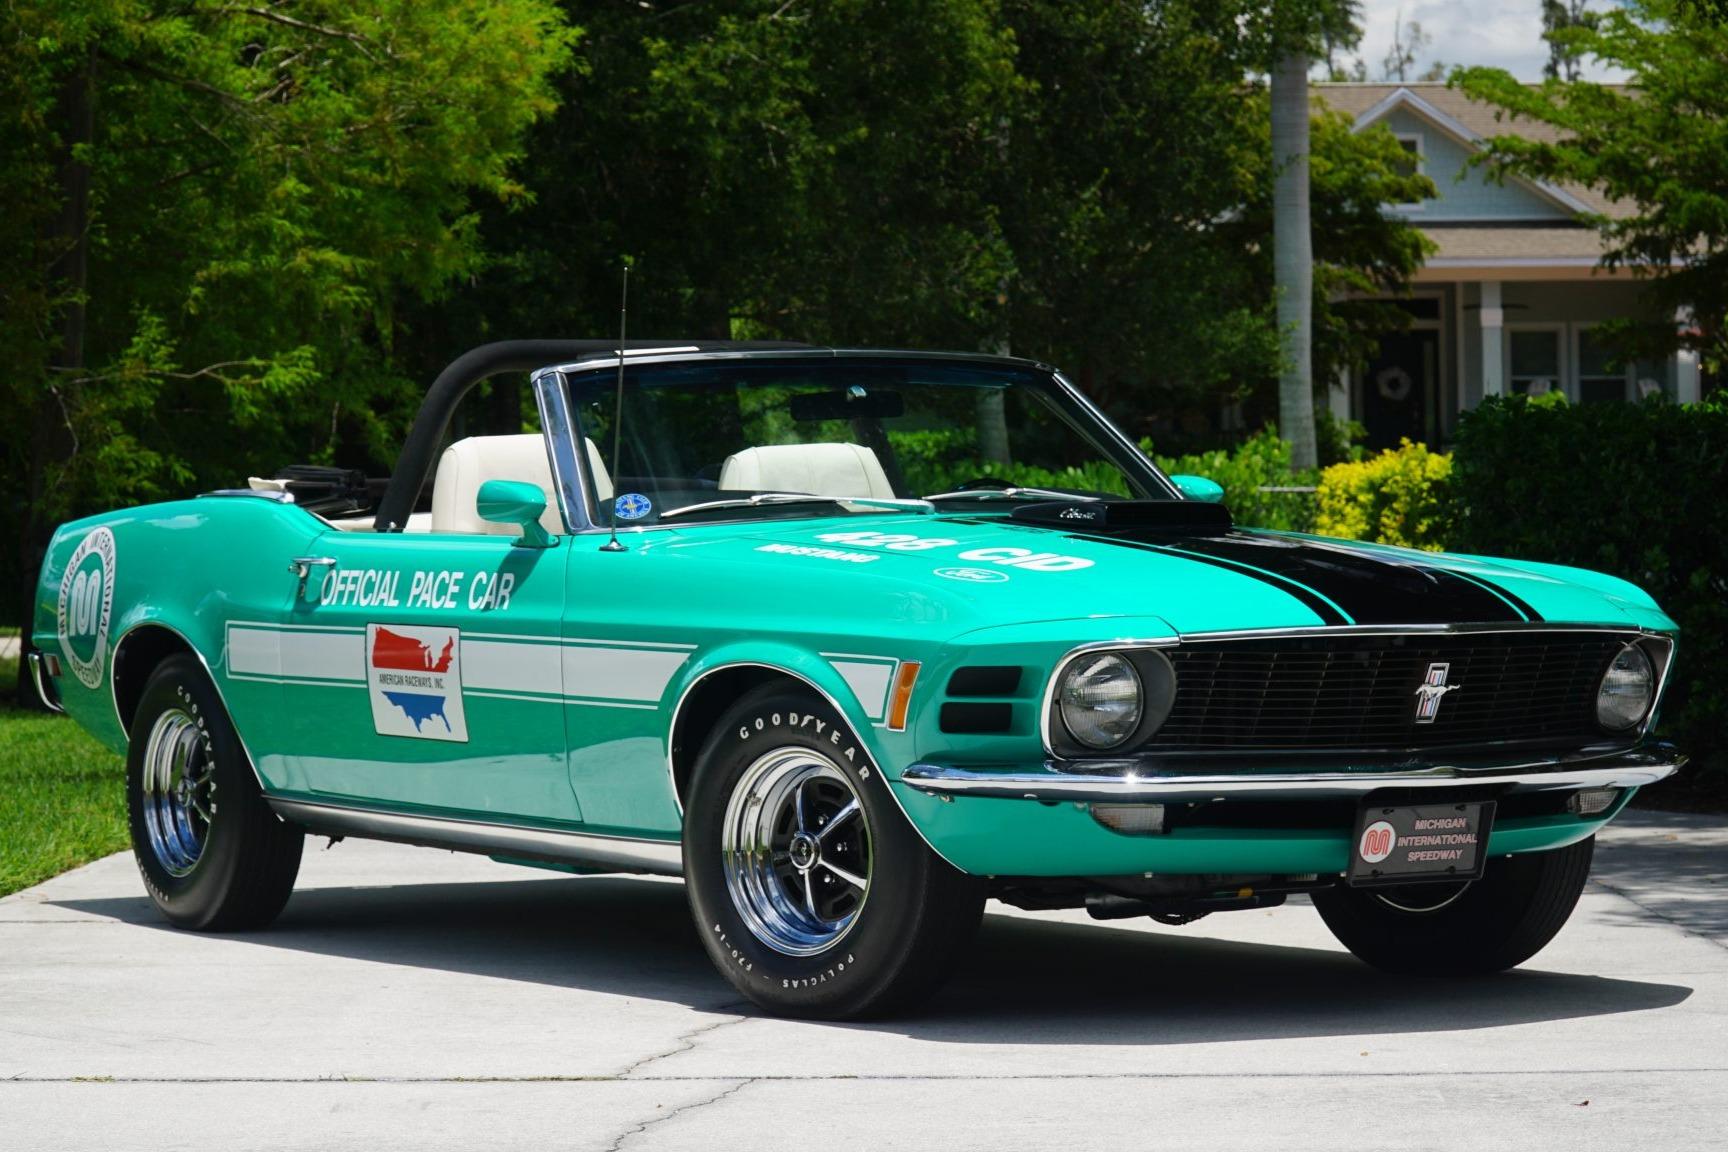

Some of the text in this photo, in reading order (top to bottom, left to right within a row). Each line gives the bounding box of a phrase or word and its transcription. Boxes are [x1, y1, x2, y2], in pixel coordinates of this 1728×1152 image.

[753, 543, 881, 564] MUSTANG
[814, 531, 1096, 572] 428 CID
[321, 568, 515, 610] OFFICIAL PACE CAR
[379, 673, 404, 685] AMERICAN
[434, 677, 445, 689] INC.
[739, 711, 871, 783] GOODYEAR
[1414, 817, 1467, 831] MICHIGAN
[1397, 833, 1478, 847] INTERNATIONAL
[1407, 849, 1464, 862] SPEEDWAY
